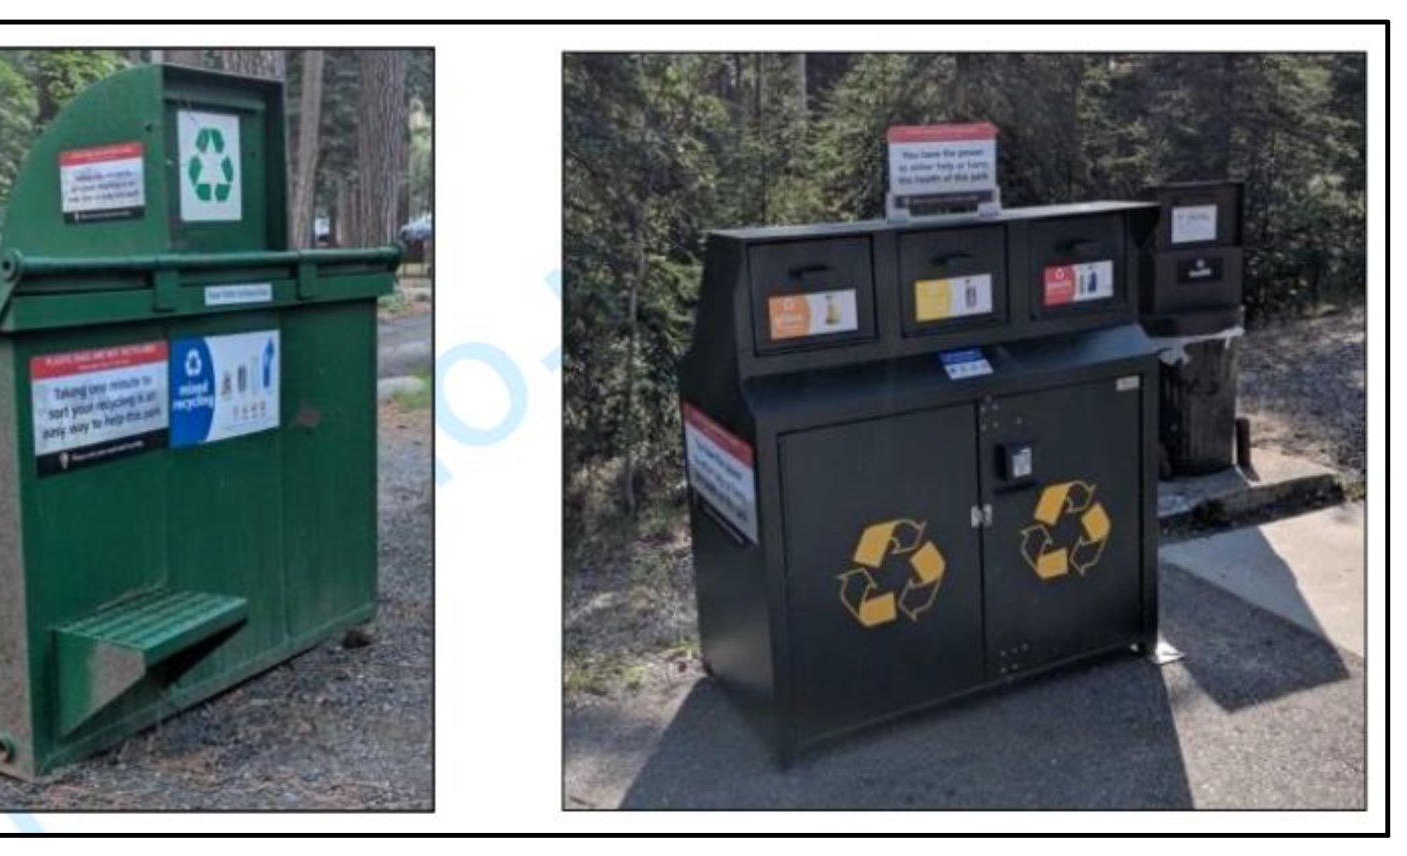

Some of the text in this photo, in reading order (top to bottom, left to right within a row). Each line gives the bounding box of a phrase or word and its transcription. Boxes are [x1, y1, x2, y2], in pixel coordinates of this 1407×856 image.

[54, 386, 87, 400] Taking
[88, 384, 106, 395] one
[109, 378, 140, 391] minute
[179, 379, 209, 396] mixed
[48, 406, 69, 420] sort
[71, 403, 93, 419] your
[96, 396, 136, 412] recycling
[172, 395, 214, 412] recycling
[42, 427, 67, 440] easy
[69, 423, 90, 435] way
[104, 414, 124, 427] help
